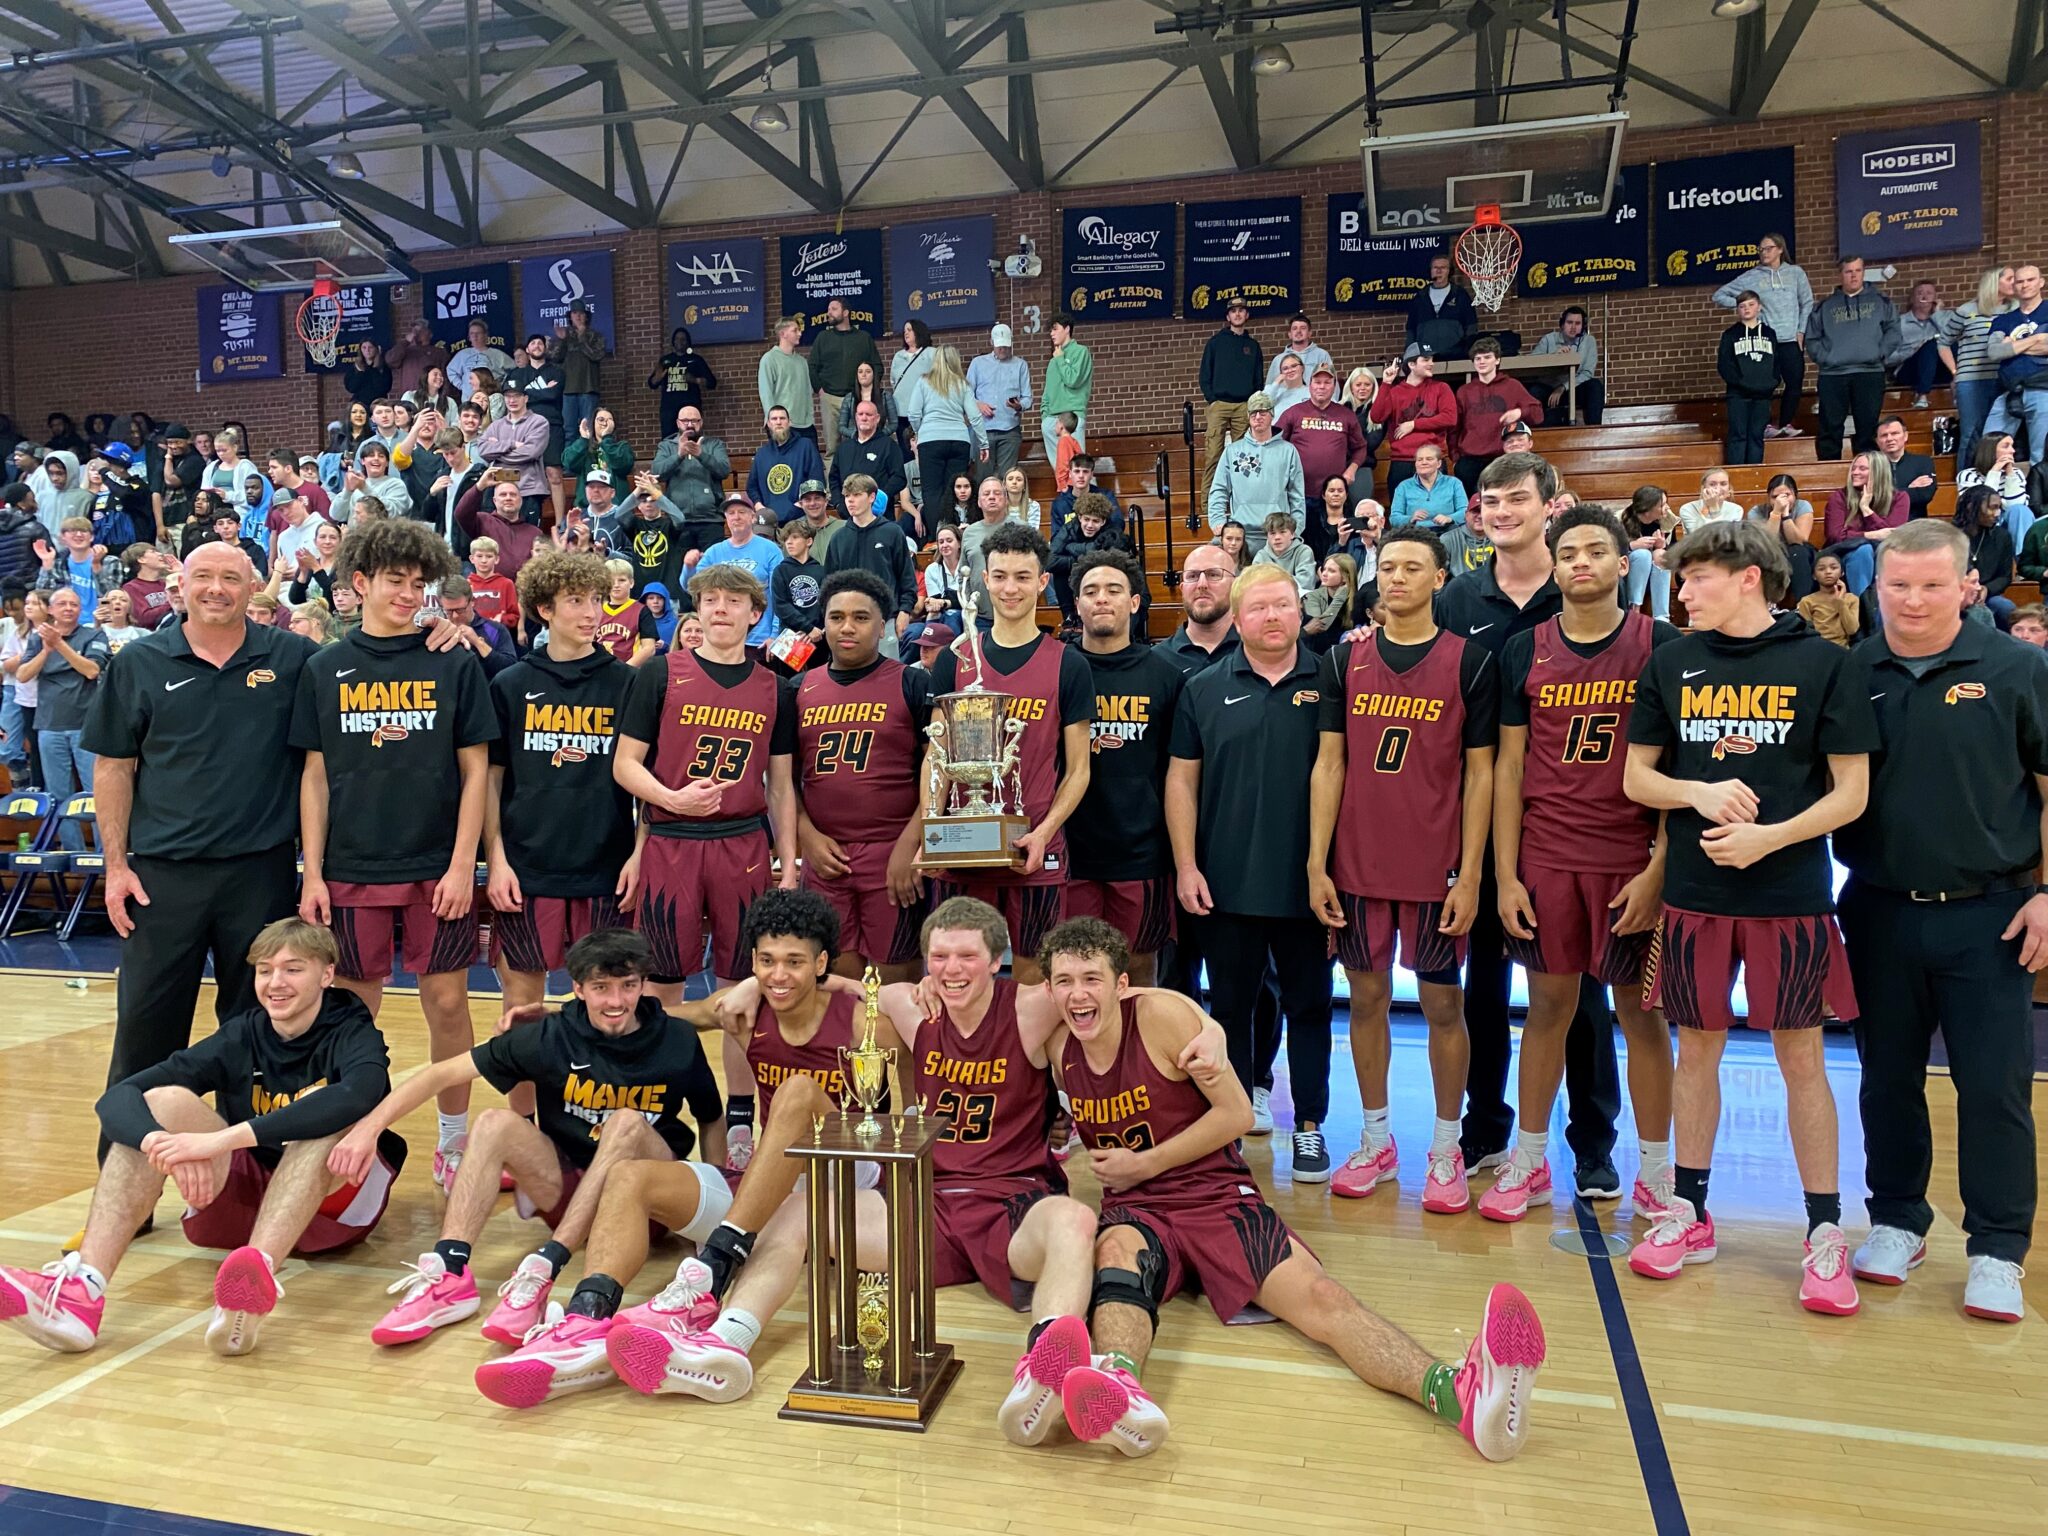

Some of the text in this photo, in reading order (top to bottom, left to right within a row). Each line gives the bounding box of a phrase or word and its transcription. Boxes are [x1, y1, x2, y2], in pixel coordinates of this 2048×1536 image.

[1870, 150, 1948, 170] MODERN
[1880, 181, 1939, 196] AUTOMOTIVE
[1887, 207, 1959, 224] MT. TABOR
[1903, 219, 1944, 230] SPARTANS
[1088, 226, 1160, 251] Allegacy
[1340, 238, 1361, 252] DELI
[792, 240, 848, 277] Jostens
[1696, 244, 1760, 265] MT. TAB
[805, 269, 862, 282] Jake Honeycutt
[1555, 258, 1637, 278] MT. TABOR
[1715, 260, 1760, 271] SPARTAN
[469, 279, 489, 291] Bell
[796, 282, 809, 290] Grad
[810, 281, 834, 289] Products
[855, 278, 871, 287] Rings
[1360, 277, 1429, 294] MT. TABO
[1573, 273, 1618, 284] SPARTANS
[470, 291, 498, 303] Davis
[805, 286, 863, 299] 1-800-JOSTENS
[927, 288, 978, 301] MT. TABOR
[1093, 286, 1163, 302] MT. TABOR
[1216, 285, 1288, 301] MT. TABOR
[1377, 293, 1416, 301] SPARTAN
[470, 304, 488, 316] Pitt
[702, 305, 749, 316] MT. TABOR
[1109, 300, 1147, 309] SPARTANS
[850, 310, 873, 323] BOR
[1023, 305, 1041, 334] 3
[222, 338, 254, 351] SUSHI
[450, 339, 468, 353] MT.
[1301, 418, 1343, 432] SAURAS
[596, 622, 630, 643] SOUTH
[339, 680, 437, 712] MAKE
[1680, 685, 1798, 720] MAKE
[801, 702, 888, 728] SAURAS
[1095, 695, 1150, 722] AKE
[1352, 693, 1445, 722] SAURAS
[340, 710, 437, 733] HISTORY
[524, 703, 615, 735] MAKE
[679, 703, 767, 735] SAURAS
[1561, 712, 1620, 764] 15
[1679, 718, 1795, 745] HISTORY
[523, 731, 613, 755] HISTORY
[815, 729, 875, 775] 24
[1373, 726, 1412, 774] 0
[687, 734, 753, 783] 33
[924, 1050, 1008, 1086] SAURAS
[563, 1073, 667, 1113] MAKE
[934, 1089, 997, 1143] 23
